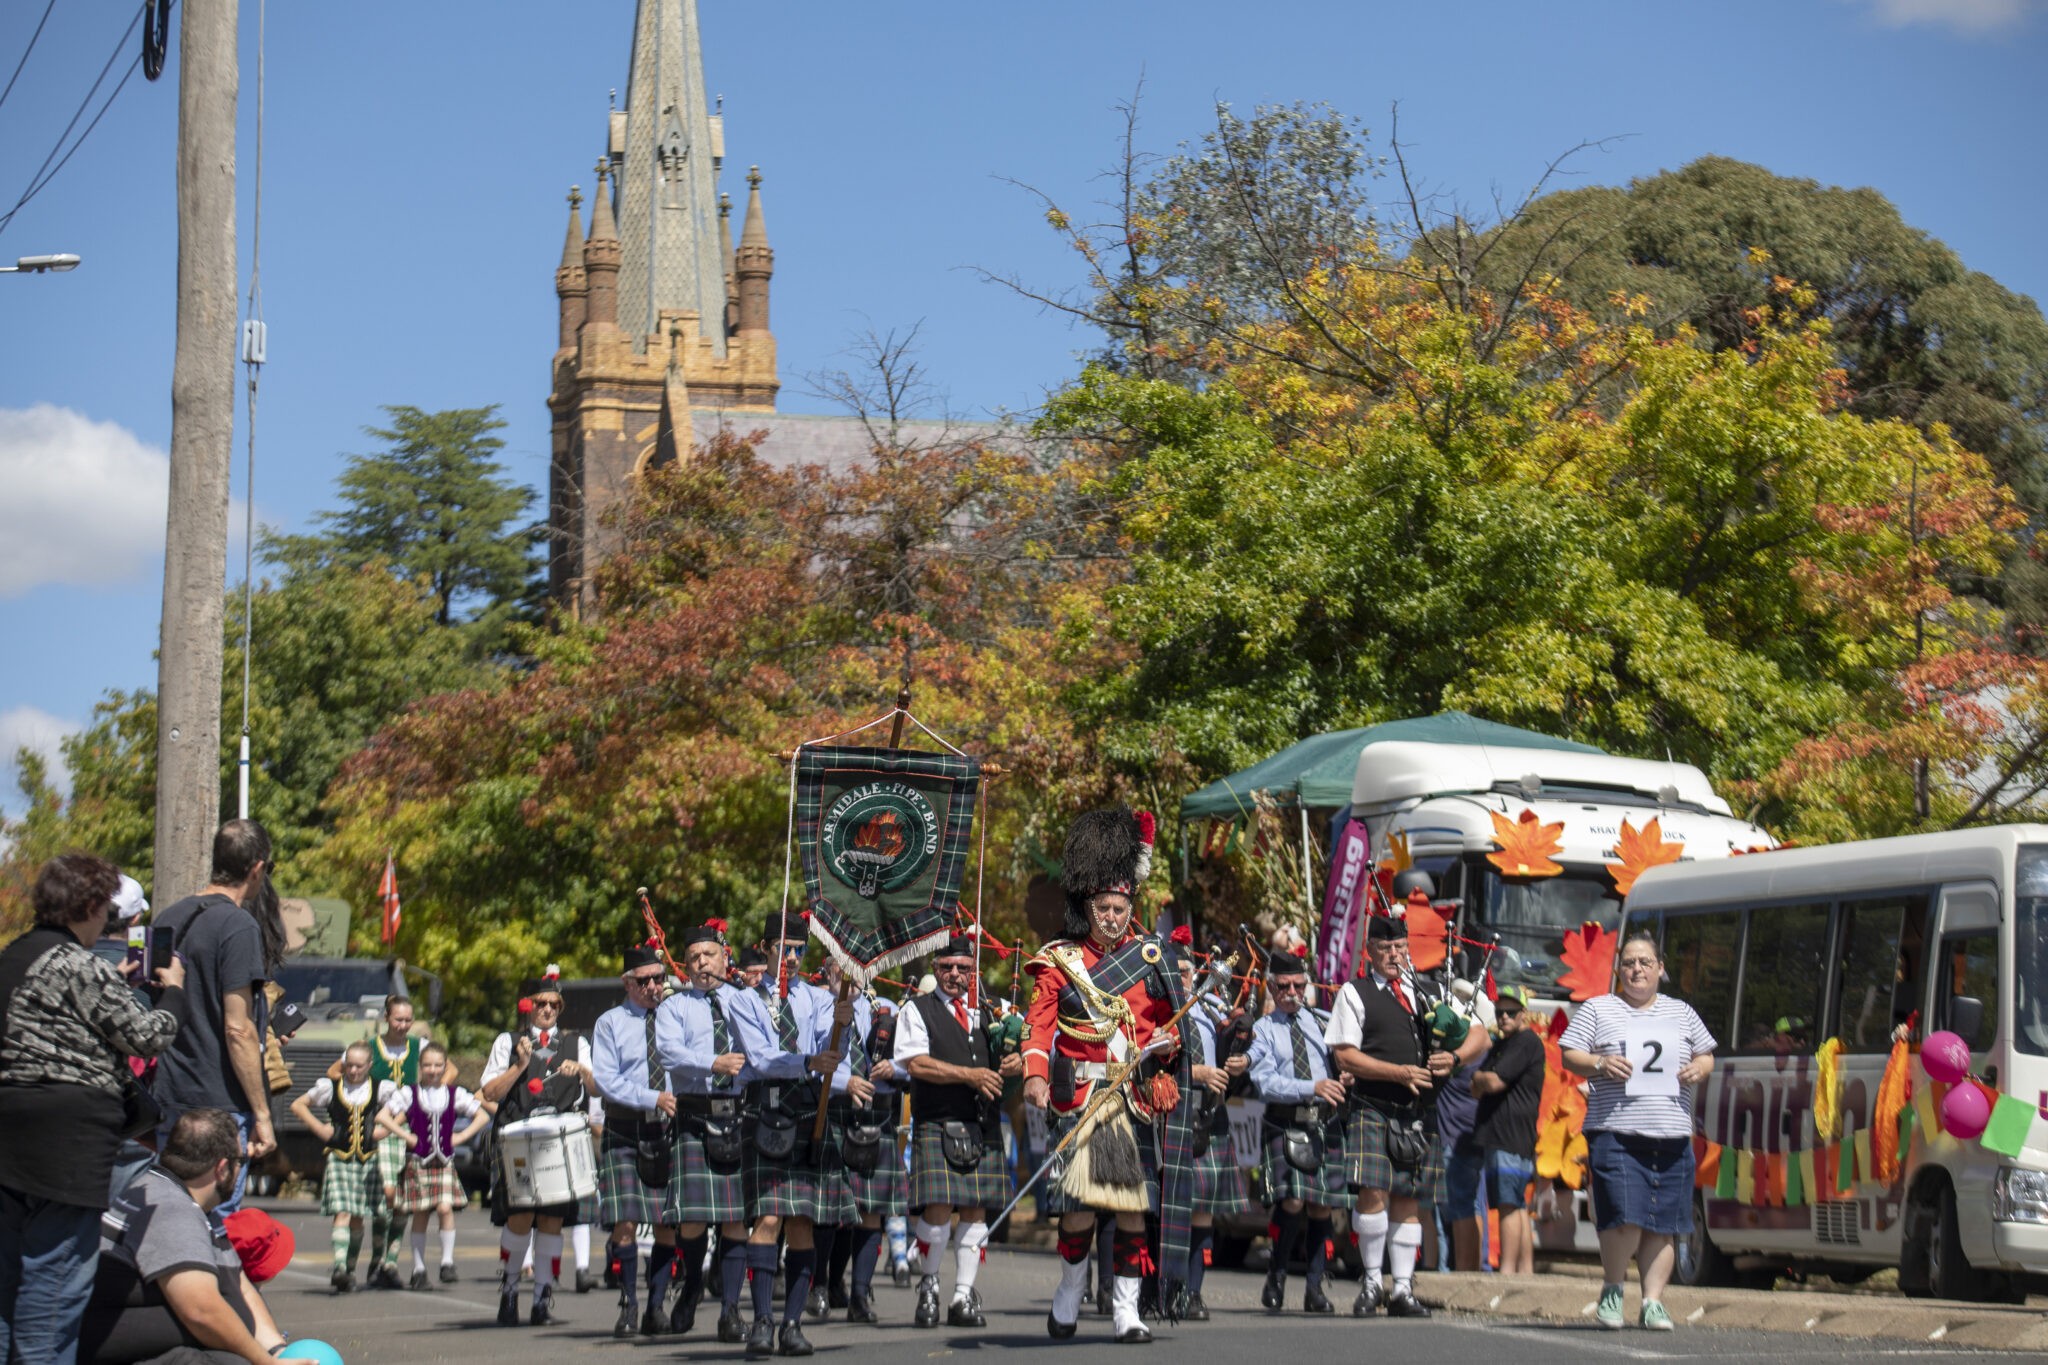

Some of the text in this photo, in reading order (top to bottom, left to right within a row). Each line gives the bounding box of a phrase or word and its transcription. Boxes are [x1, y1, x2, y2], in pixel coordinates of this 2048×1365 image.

[824, 782, 938, 855] ARMIDALE PIPE BAND
[1642, 1040, 1663, 1073] 2
